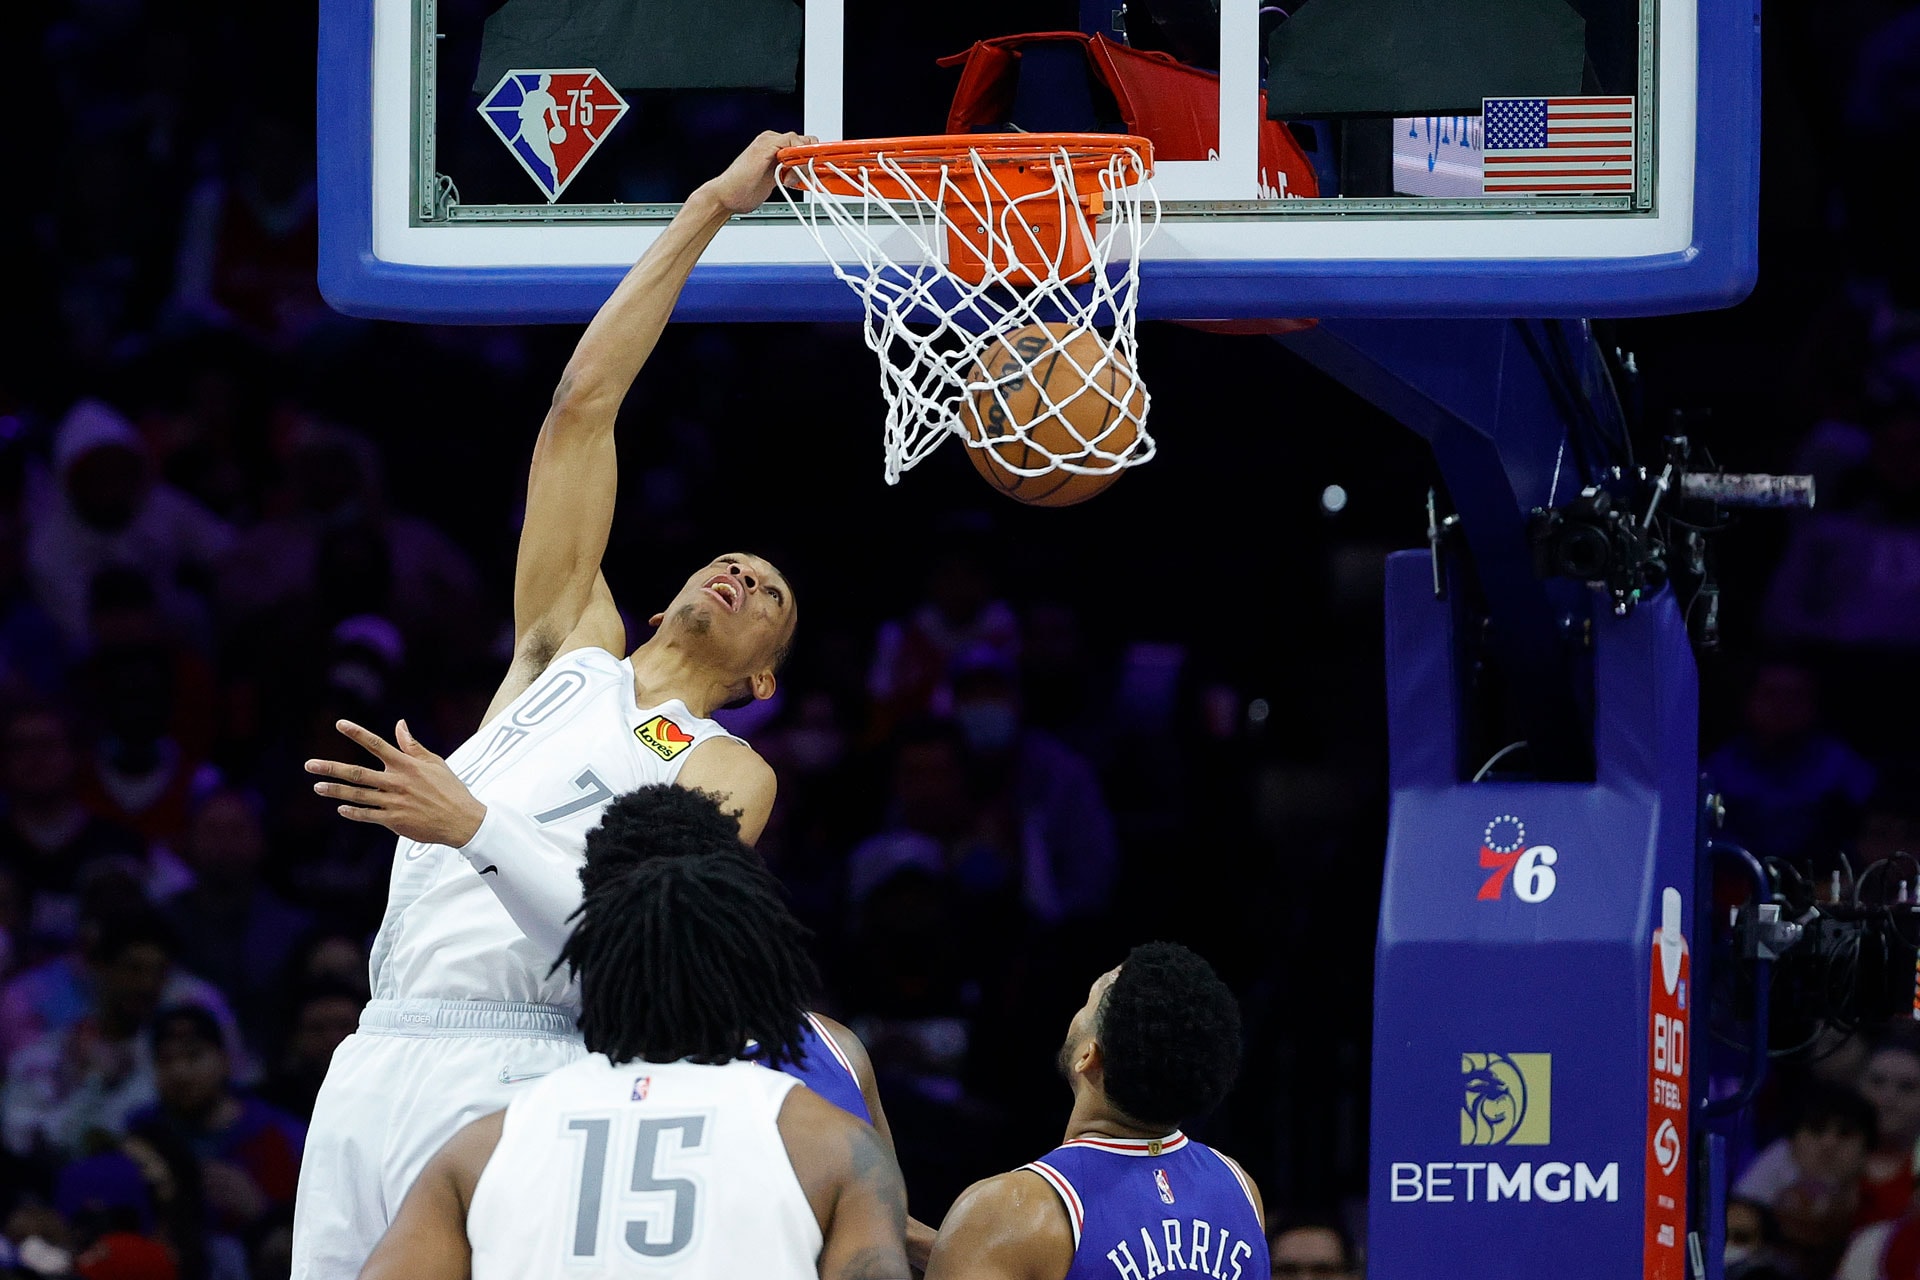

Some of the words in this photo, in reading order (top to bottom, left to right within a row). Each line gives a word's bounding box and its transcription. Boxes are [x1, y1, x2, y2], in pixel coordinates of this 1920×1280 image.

[567, 90, 593, 126] 75
[533, 768, 614, 824] 7
[1477, 845, 1558, 903] 76
[1654, 1013, 1684, 1076] BIO
[1654, 1078, 1681, 1110] STEEL
[566, 1115, 706, 1257] 15
[1391, 1162, 1619, 1202] BETMGM
[1106, 1218, 1252, 1280] HARRIS
